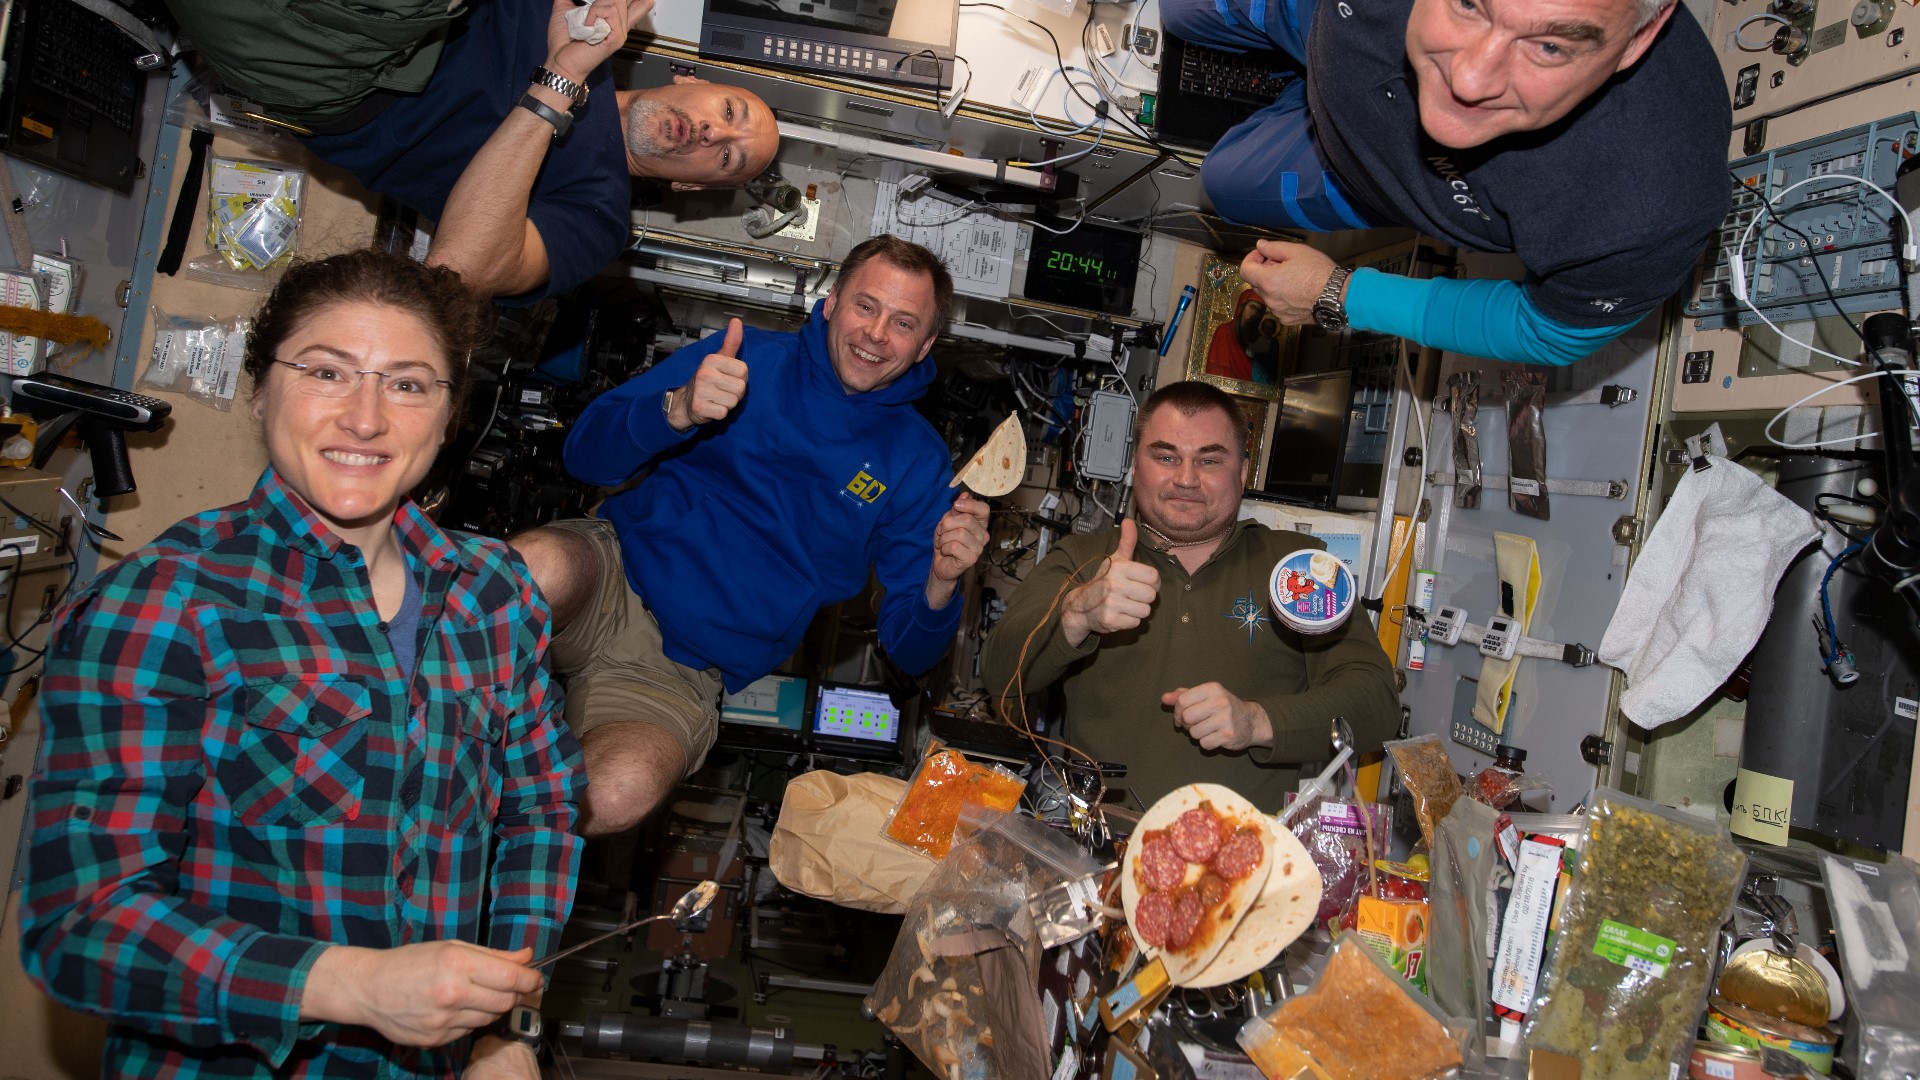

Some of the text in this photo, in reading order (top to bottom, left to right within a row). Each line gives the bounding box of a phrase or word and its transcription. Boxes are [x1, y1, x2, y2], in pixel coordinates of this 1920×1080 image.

[1047, 250, 1104, 276] 20:44
[847, 470, 886, 503] 60
[1232, 598, 1258, 623] 58
[1521, 864, 1529, 873] by
[1514, 873, 1527, 899] Discard
[1511, 911, 1519, 924] Use
[1403, 950, 1422, 980] J7
[1495, 965, 1512, 1004] Refrigerate
[1505, 935, 1515, 956] Merlin
[1506, 948, 1523, 996] After Opening
